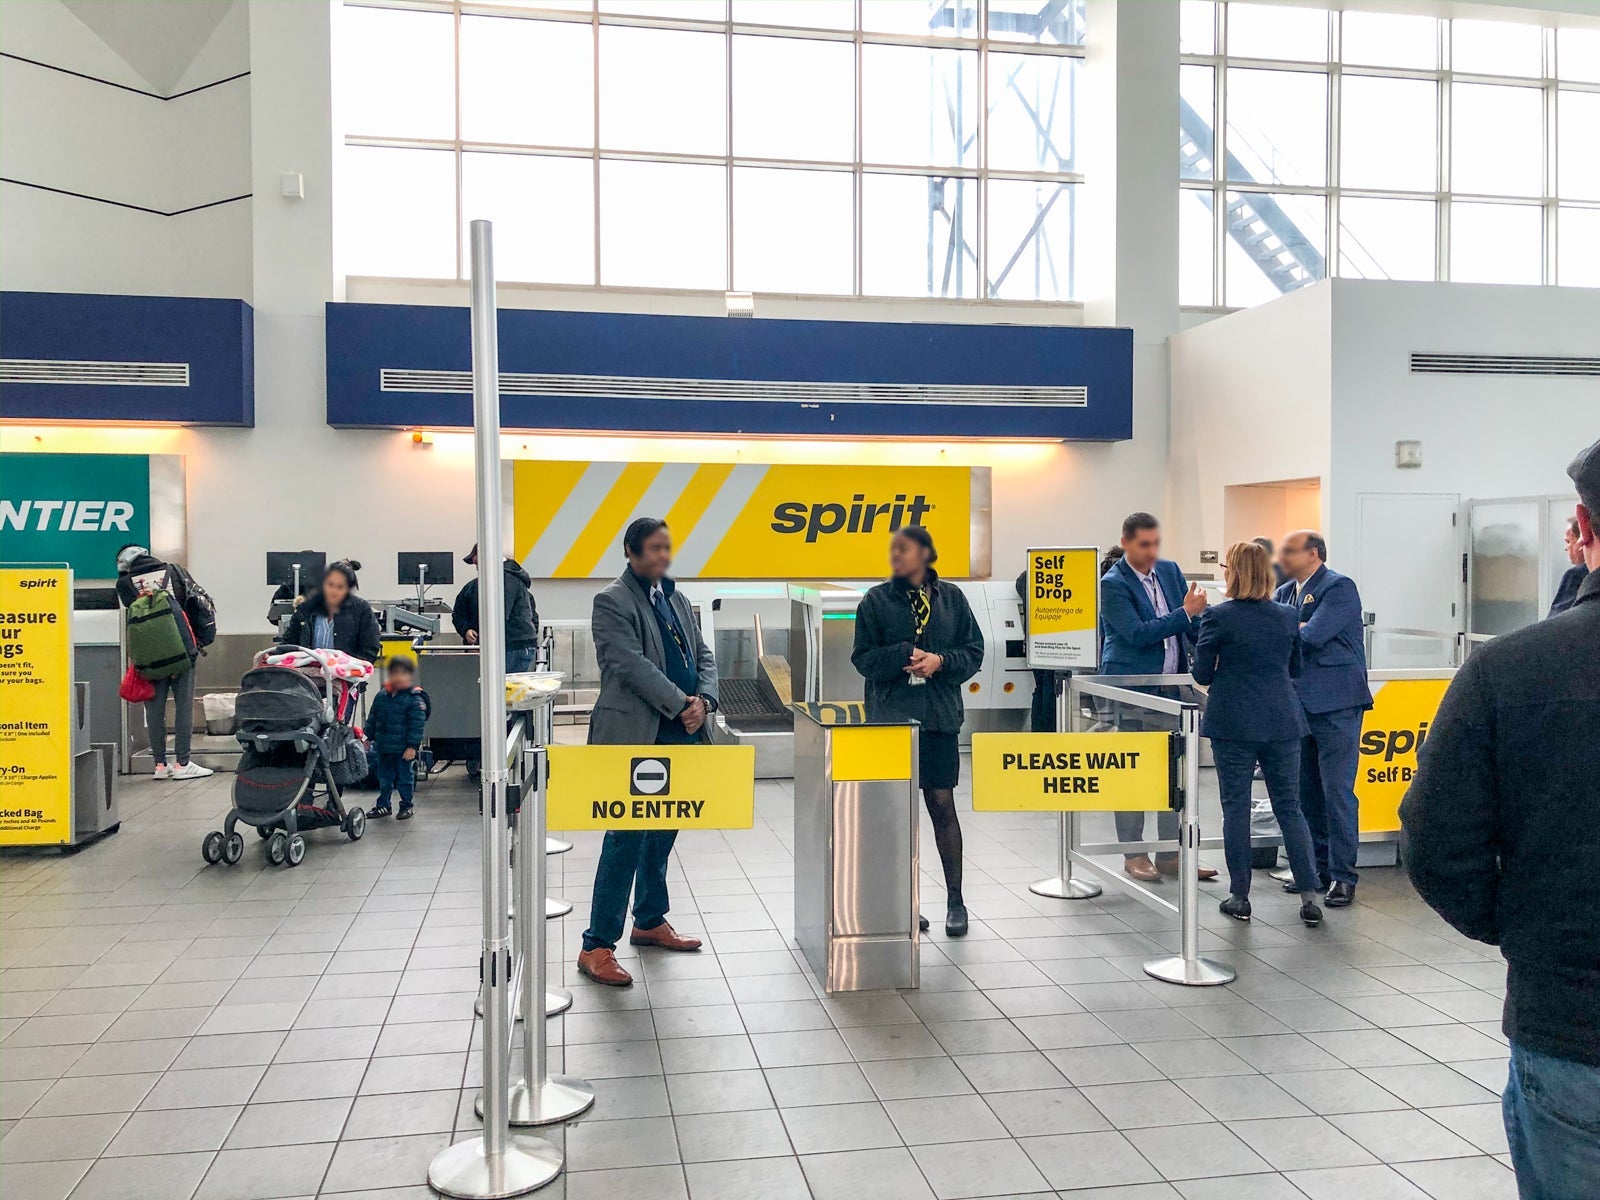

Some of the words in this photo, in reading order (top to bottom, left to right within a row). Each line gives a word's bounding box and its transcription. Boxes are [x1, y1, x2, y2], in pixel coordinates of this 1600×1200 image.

[0, 500, 134, 531] NTIER
[771, 494, 931, 543] spirit
[1035, 555, 1065, 569] Self
[19, 578, 57, 589] spirit
[1035, 571, 1063, 588] Bag
[1035, 586, 1072, 602] Drop
[1035, 607, 1074, 615] Autoentrega
[1035, 613, 1062, 622] Equipaje
[1, 628, 21, 639] ur
[26, 722, 48, 730] Item
[1002, 753, 1081, 770] PLEASE
[1086, 752, 1140, 769] WAIT
[1367, 766, 1398, 783] Self
[1402, 767, 1416, 782] B
[1044, 777, 1099, 793] HERE
[24, 810, 42, 818] Bag
[592, 800, 626, 818] NO
[632, 800, 705, 818] ENTRY
